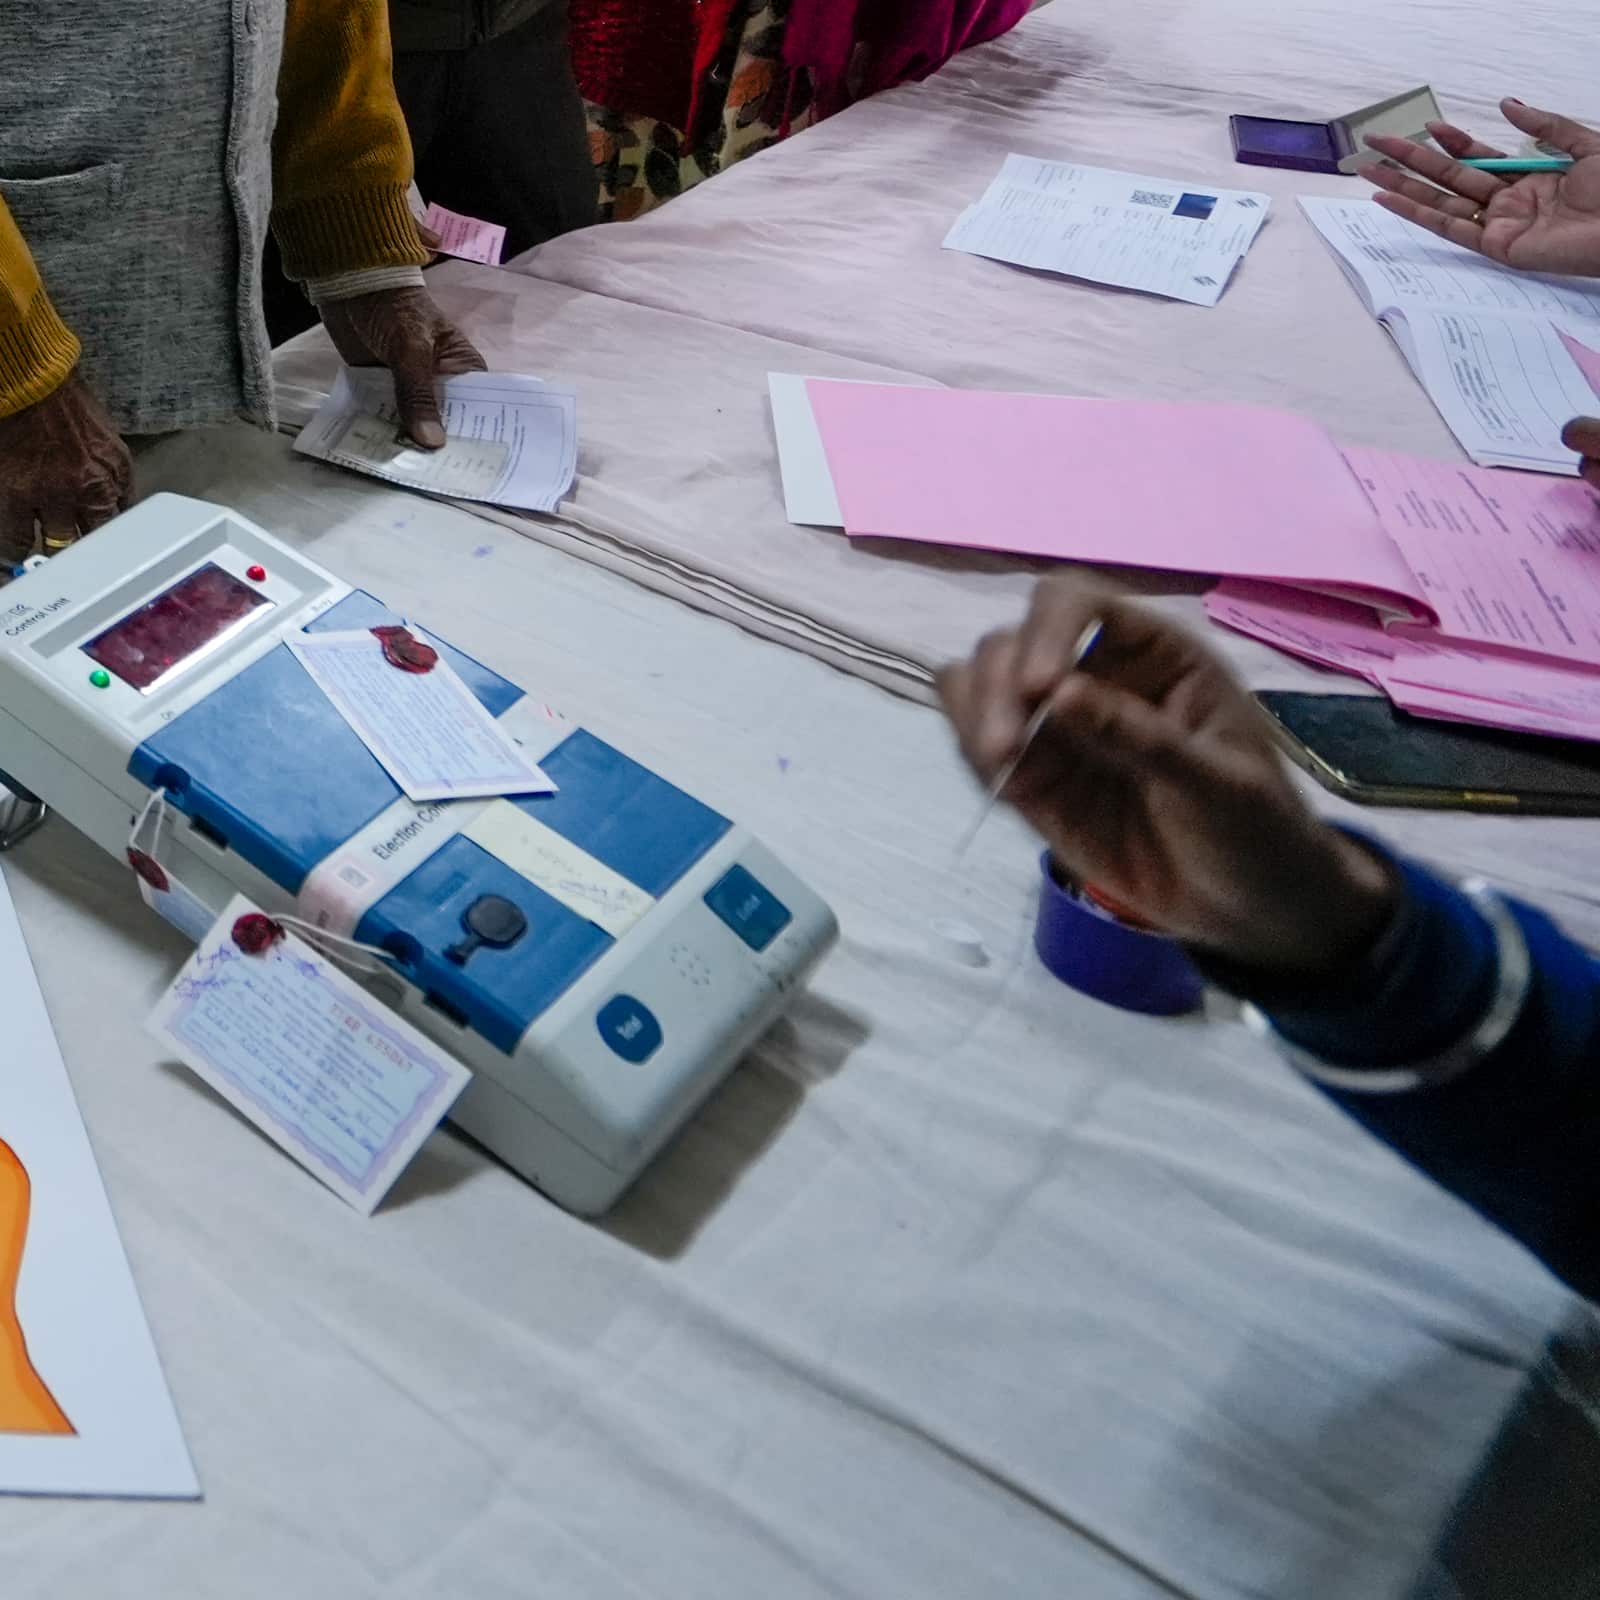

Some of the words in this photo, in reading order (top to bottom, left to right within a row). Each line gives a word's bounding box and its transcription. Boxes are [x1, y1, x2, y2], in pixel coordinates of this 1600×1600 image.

[5, 609, 47, 638] Control
[46, 596, 73, 613] Unit
[371, 817, 424, 862] Election
